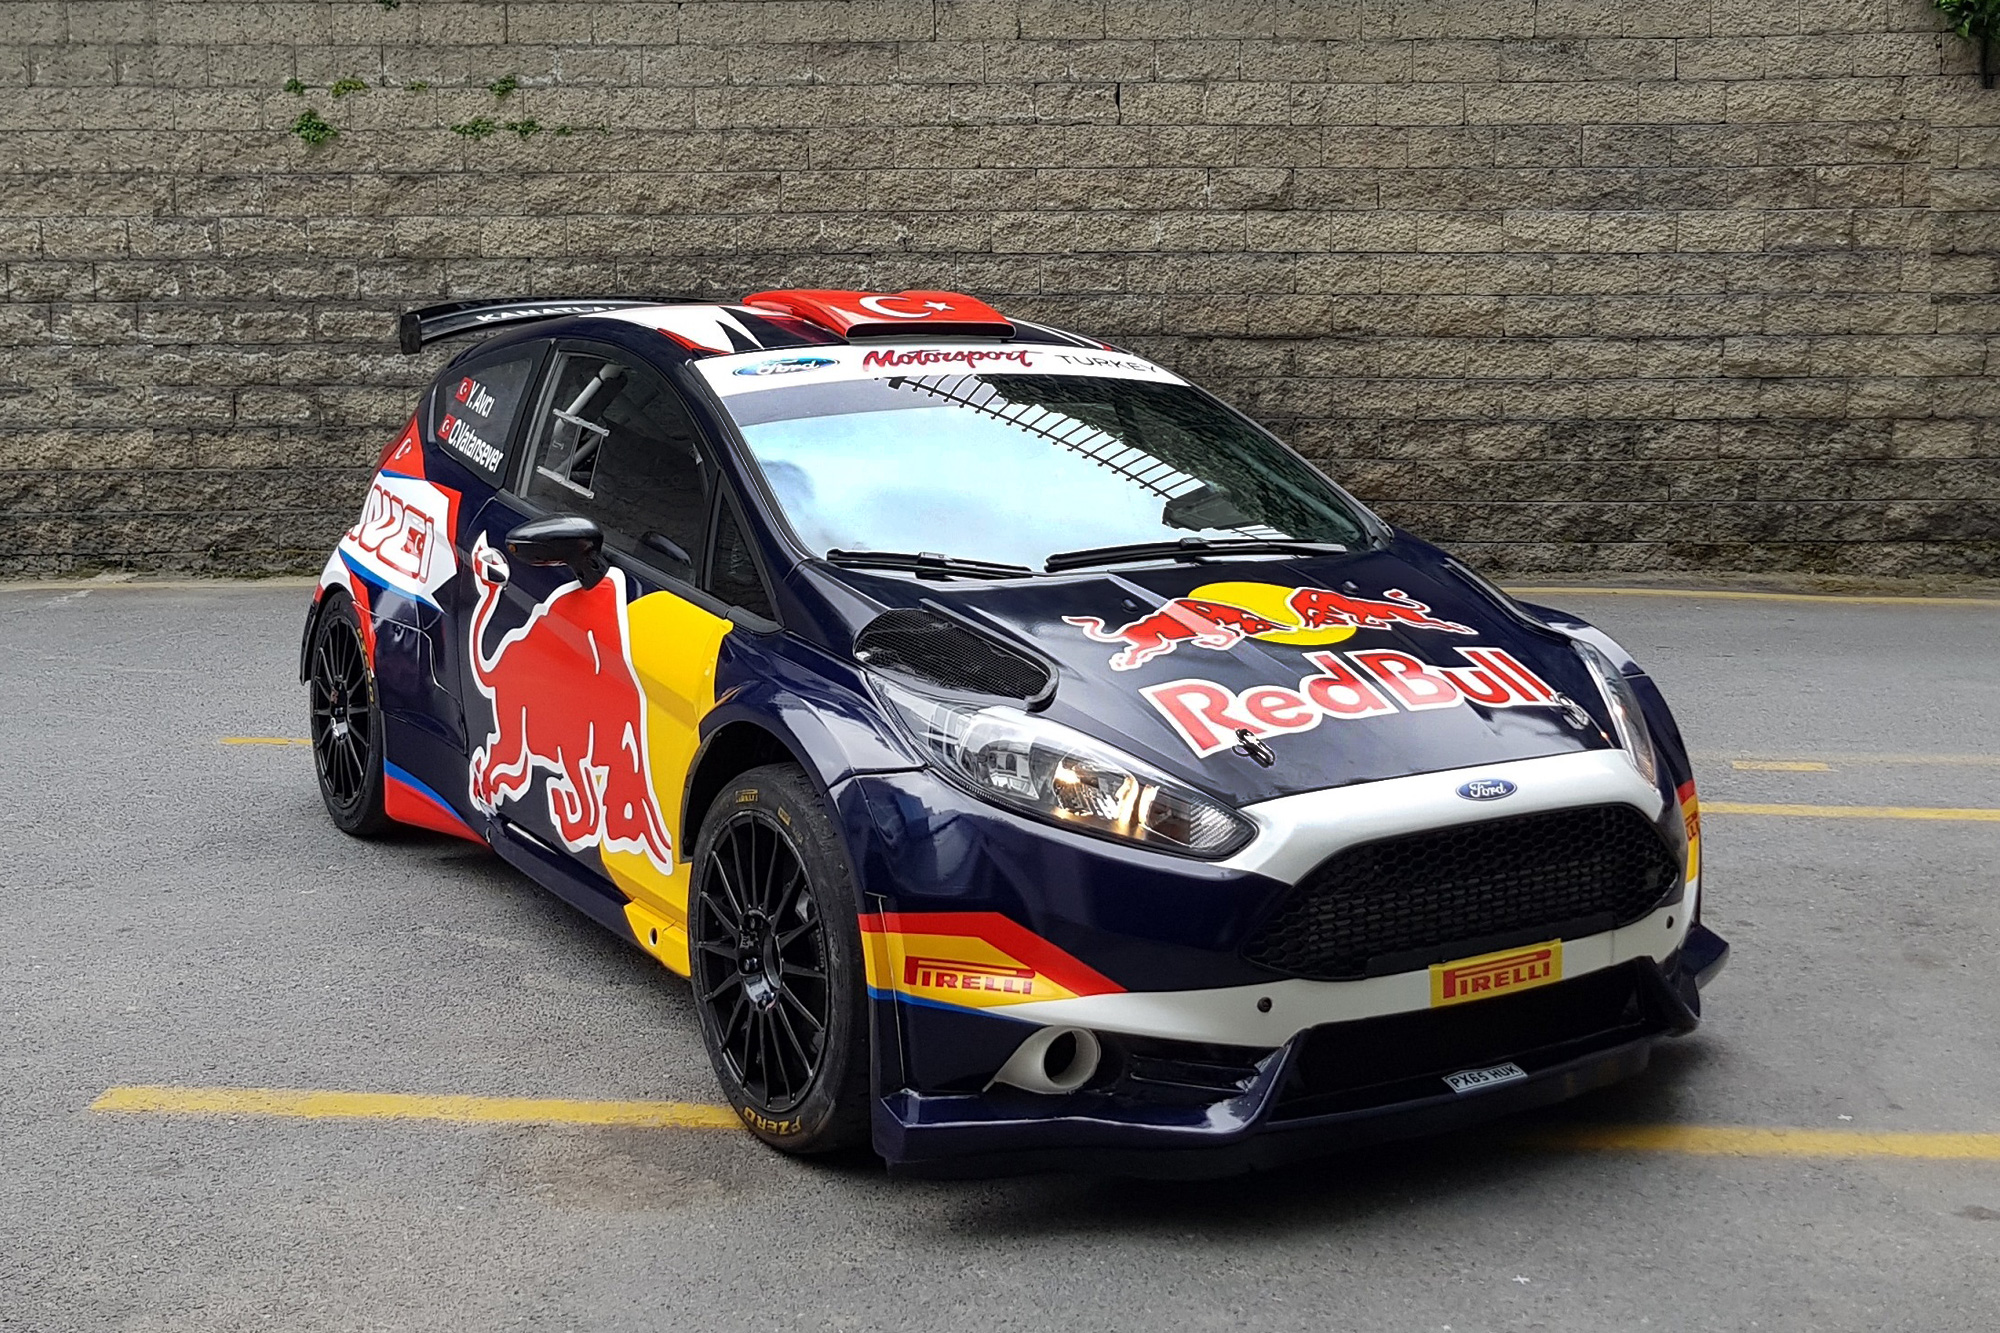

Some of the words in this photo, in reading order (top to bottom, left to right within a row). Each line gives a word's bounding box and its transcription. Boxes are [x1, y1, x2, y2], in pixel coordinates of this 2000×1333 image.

[476, 306, 616, 322] KANATLA
[862, 349, 1036, 371] Motorsport
[1054, 354, 1157, 373] TURKEY
[1469, 781, 1507, 798] Ford
[904, 955, 1035, 995] PIRELLI
[1443, 949, 1551, 999] PIRELLI
[1449, 1071, 1489, 1088] PX65
[1487, 1065, 1519, 1079] HUK
